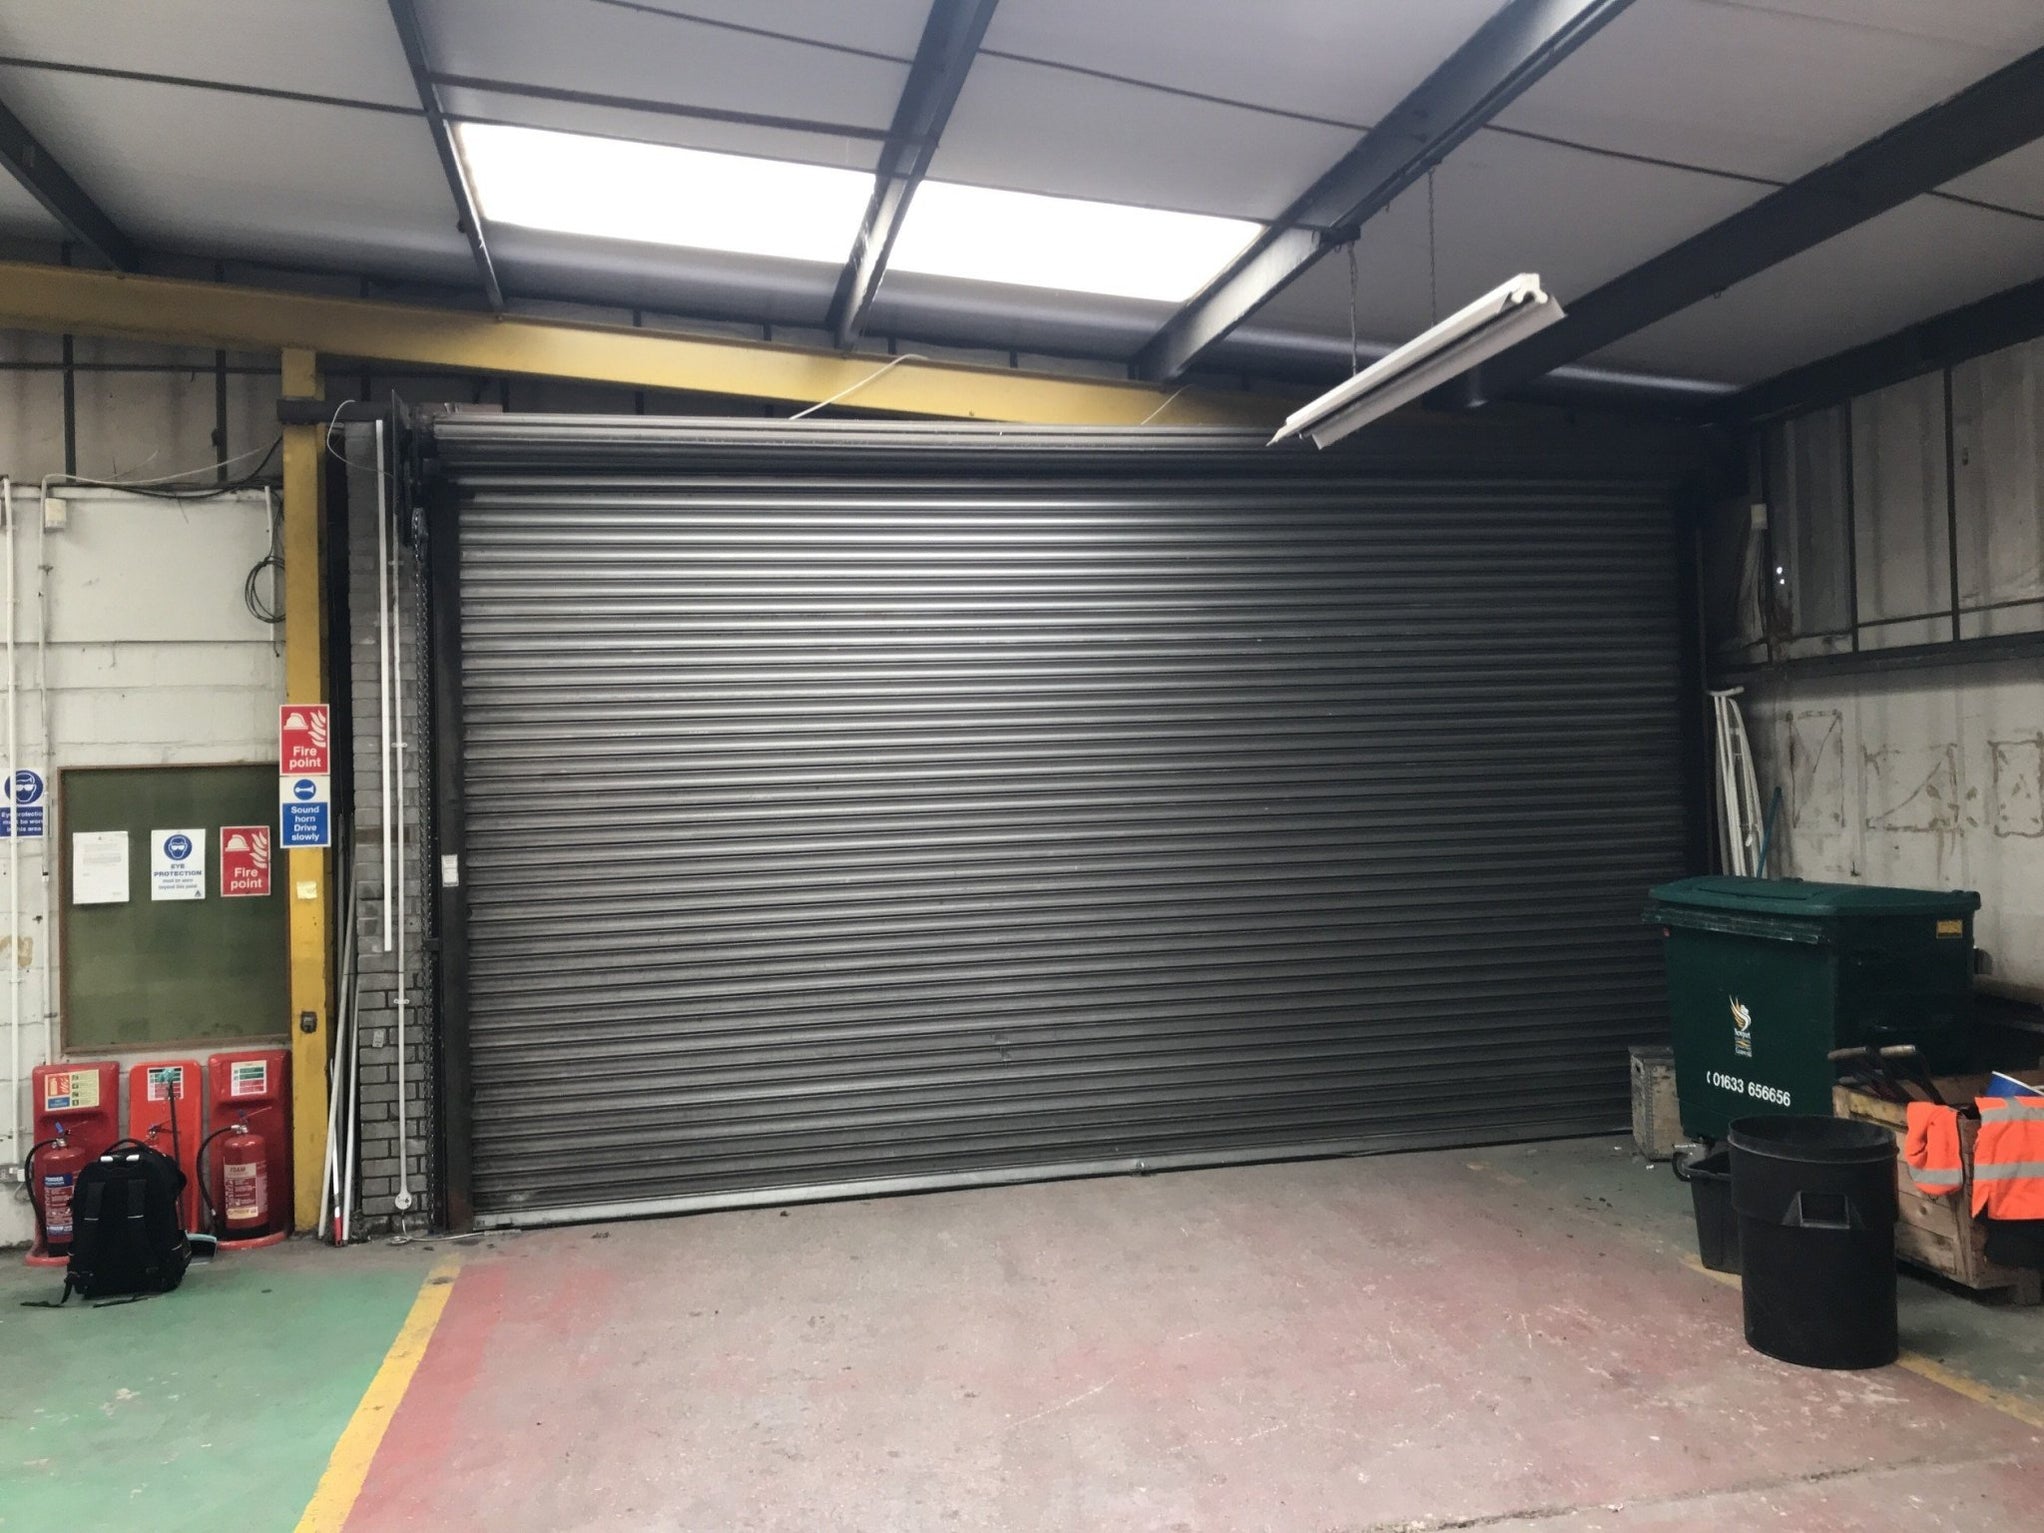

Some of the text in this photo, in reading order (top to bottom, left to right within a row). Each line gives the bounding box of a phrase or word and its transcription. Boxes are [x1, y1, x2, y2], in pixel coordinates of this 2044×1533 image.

[293, 745, 317, 757] Fire
[289, 757, 321, 771] point
[290, 806, 320, 814] Sound
[294, 815, 316, 823] horn
[293, 824, 317, 832] Drive
[291, 833, 320, 842] slowly
[234, 867, 259, 878] Fire
[230, 878, 263, 892] point
[1712, 1072, 1791, 1107] 01633 656656
